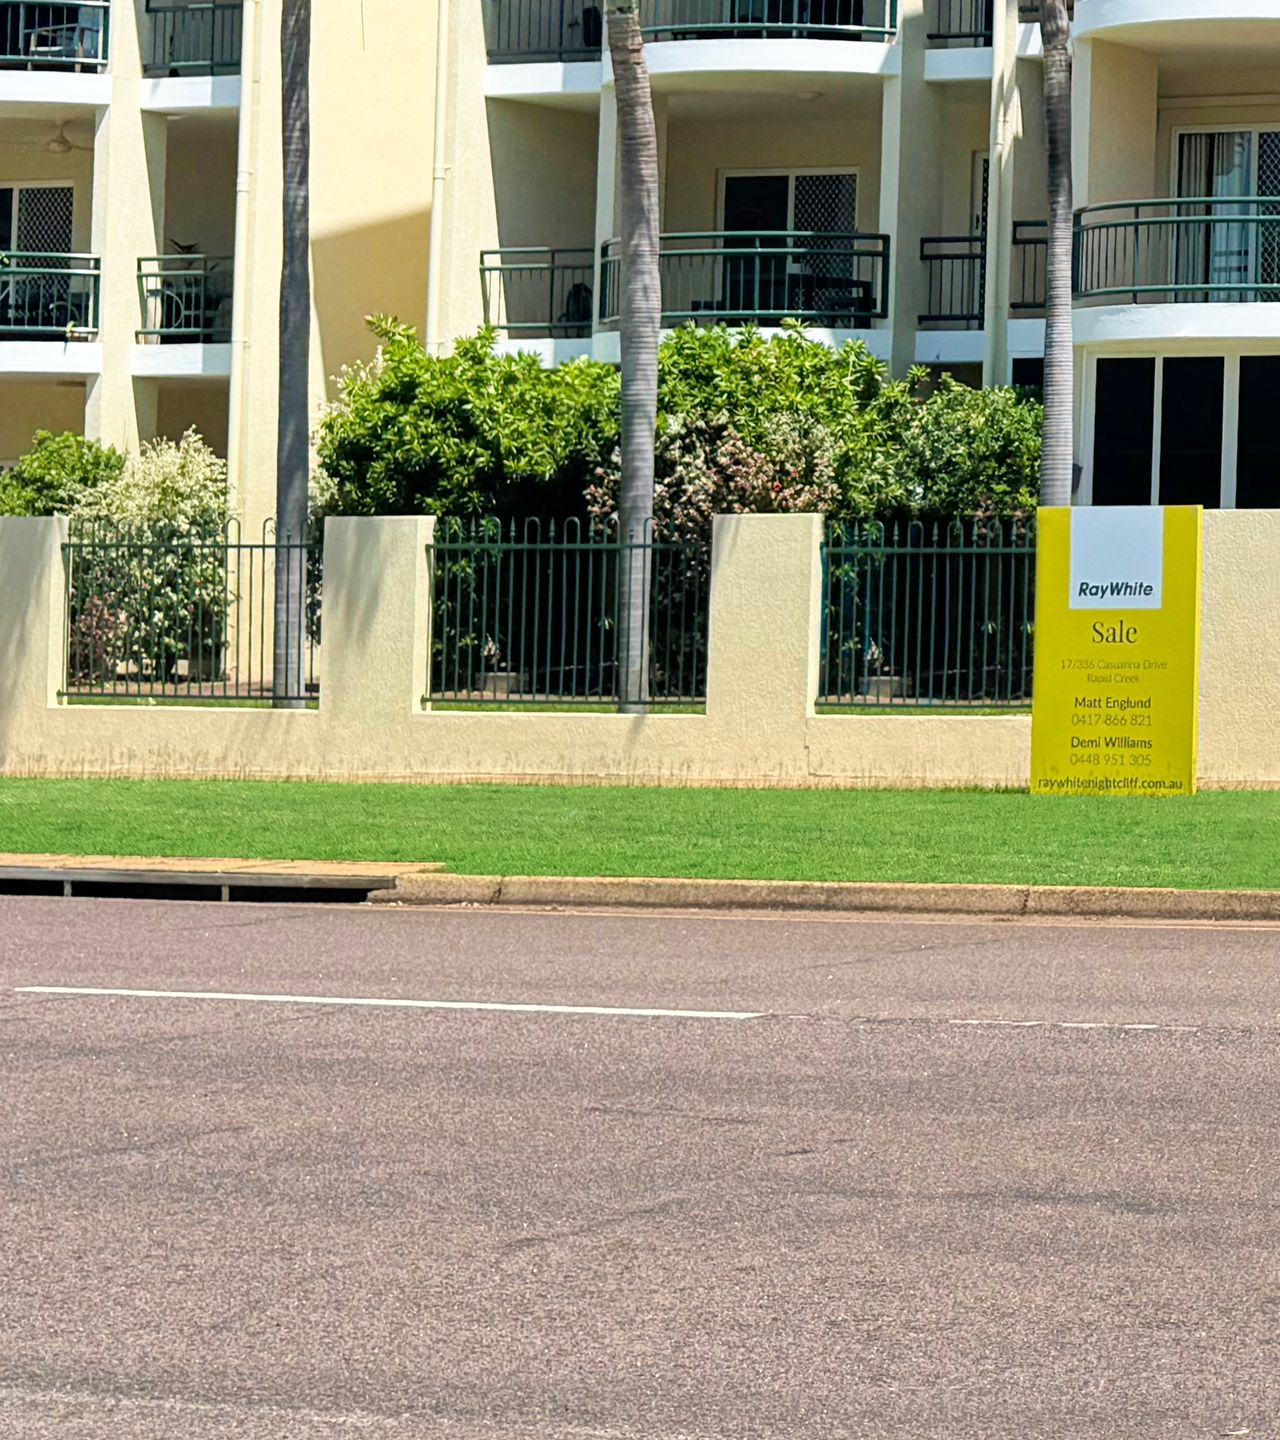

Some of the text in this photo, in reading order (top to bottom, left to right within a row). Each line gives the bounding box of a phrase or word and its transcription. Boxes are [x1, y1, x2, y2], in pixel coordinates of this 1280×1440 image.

[1092, 620, 1138, 644] Sale
[1142, 659, 1169, 670] Drive
[1114, 673, 1140, 683] Creek
[1074, 696, 1152, 711] Matt Englund
[1071, 713, 1152, 727] 0417 866 821
[1071, 736, 1153, 750] Demi Williams
[1070, 753, 1152, 767] 0448 951 305
